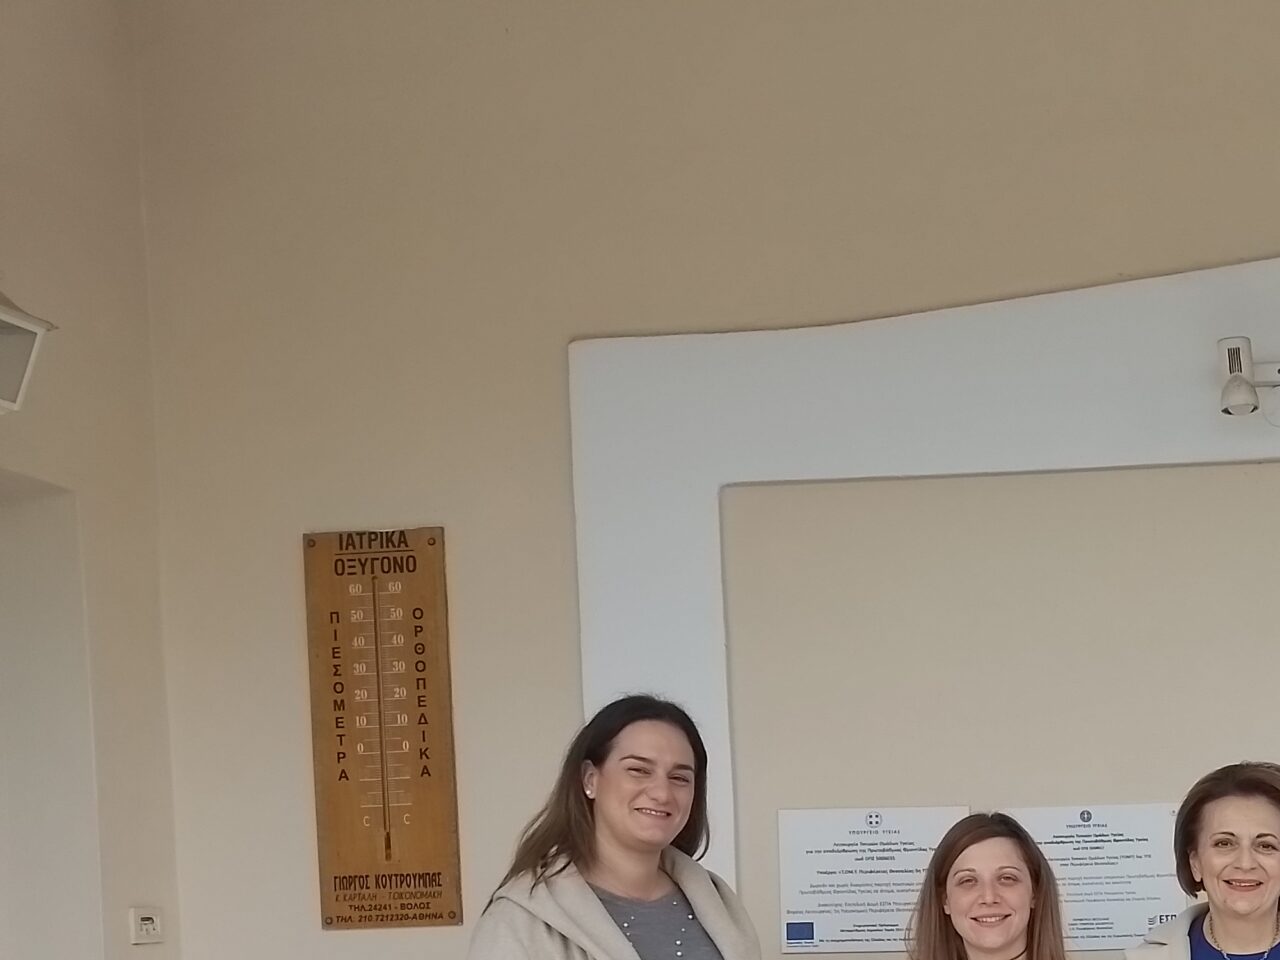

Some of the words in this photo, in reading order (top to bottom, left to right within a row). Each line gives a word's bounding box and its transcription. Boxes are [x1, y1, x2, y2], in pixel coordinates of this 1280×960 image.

[338, 530, 409, 551] ΙΑΤΡΙΚΑ
[334, 555, 417, 576] ΟΞΥΓΟΝΟ
[349, 584, 362, 594] 60
[388, 581, 402, 592] 60
[350, 610, 364, 621] 50
[390, 608, 403, 619] 50
[352, 636, 365, 647] 40
[391, 634, 404, 646] 40
[353, 663, 366, 674] 30
[392, 661, 405, 672] 30
[330, 611, 350, 782] ΠΙΕΣΟΜΕΤΡΑ
[354, 689, 368, 700] 20
[394, 687, 407, 698] 20
[412, 607, 432, 778] ΟΡΘΟΠΕΔΙΚΑ
[355, 716, 367, 727] 10
[397, 714, 408, 725] 10
[357, 743, 364, 753] 0
[402, 740, 409, 751] 0
[333, 874, 371, 892] ΓΙΩΡΓΟΣ
[375, 872, 442, 890] ΚΟΥΤΡΟΥΜΠΑΣ
[400, 901, 432, 911] ΒΟΛΟΣ
